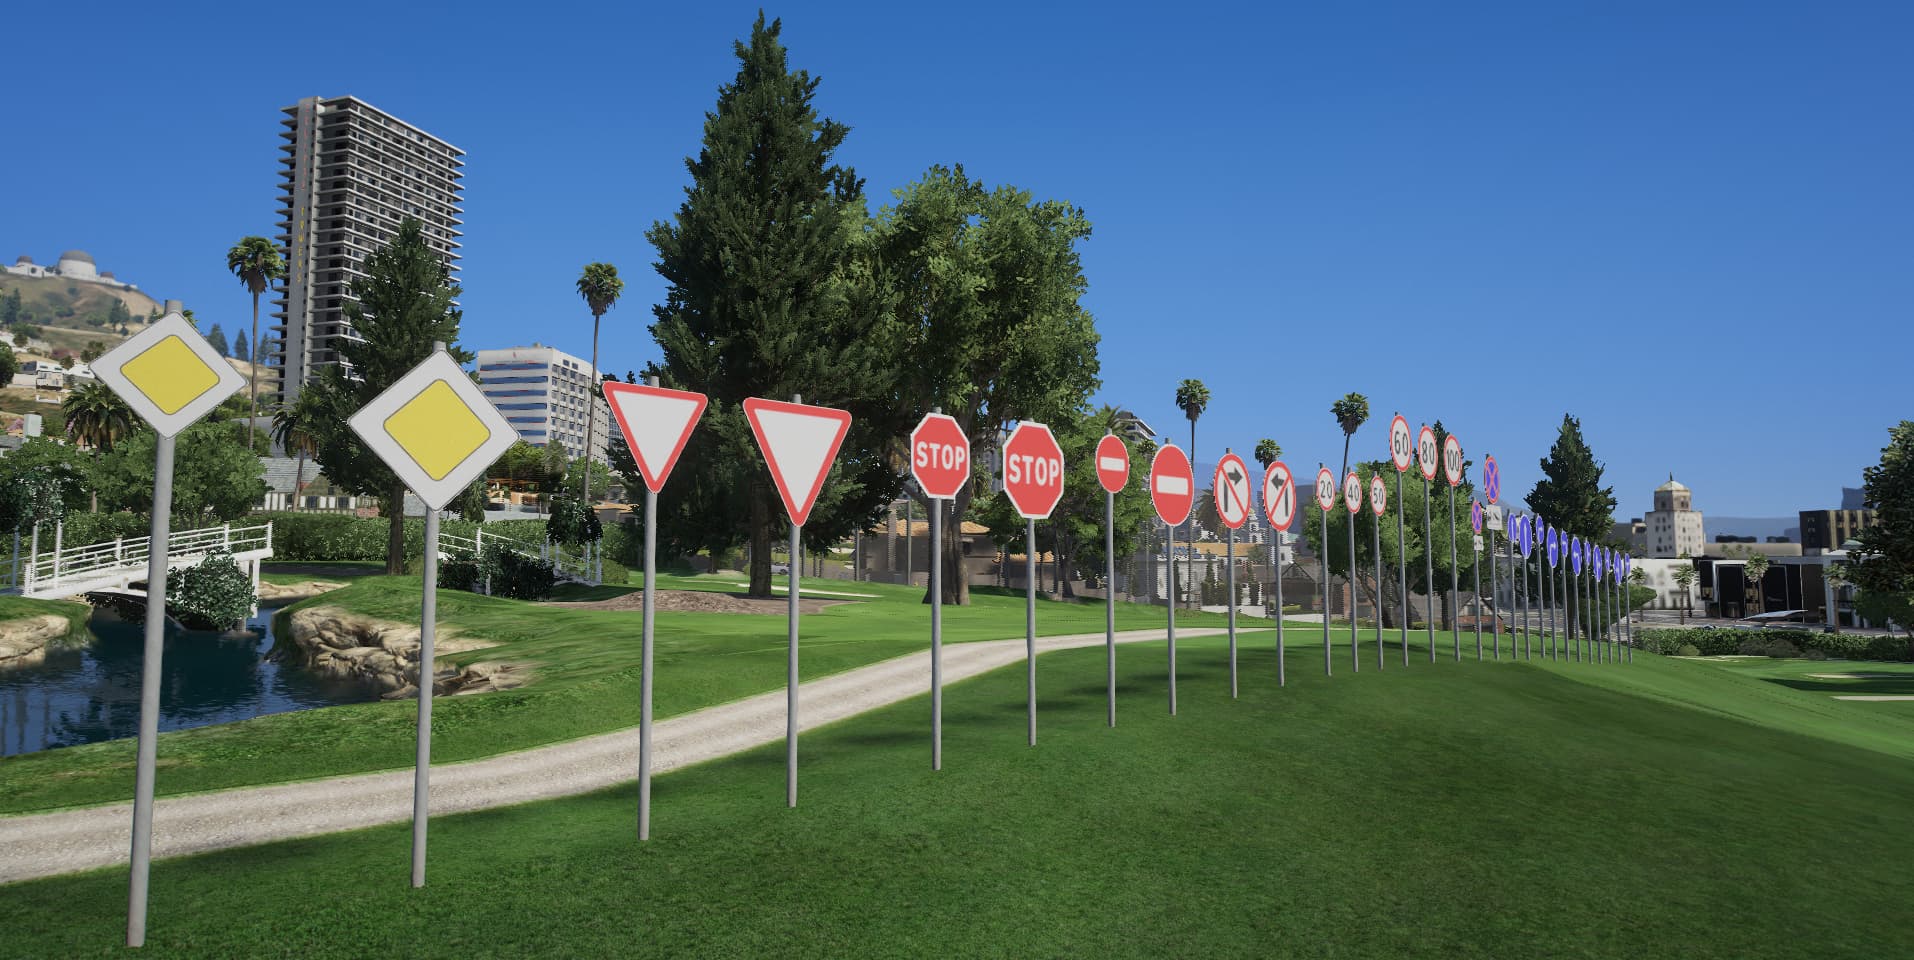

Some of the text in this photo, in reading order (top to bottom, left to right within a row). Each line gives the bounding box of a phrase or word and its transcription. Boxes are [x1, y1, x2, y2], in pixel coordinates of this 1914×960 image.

[1394, 431, 1408, 456] 60
[1422, 441, 1434, 465] 80
[916, 441, 965, 470] STOP
[1447, 449, 1460, 472] 100
[1008, 454, 1060, 486] STOP
[1320, 480, 1333, 499] 20
[1347, 484, 1360, 501] 40
[1373, 487, 1384, 504] 50
